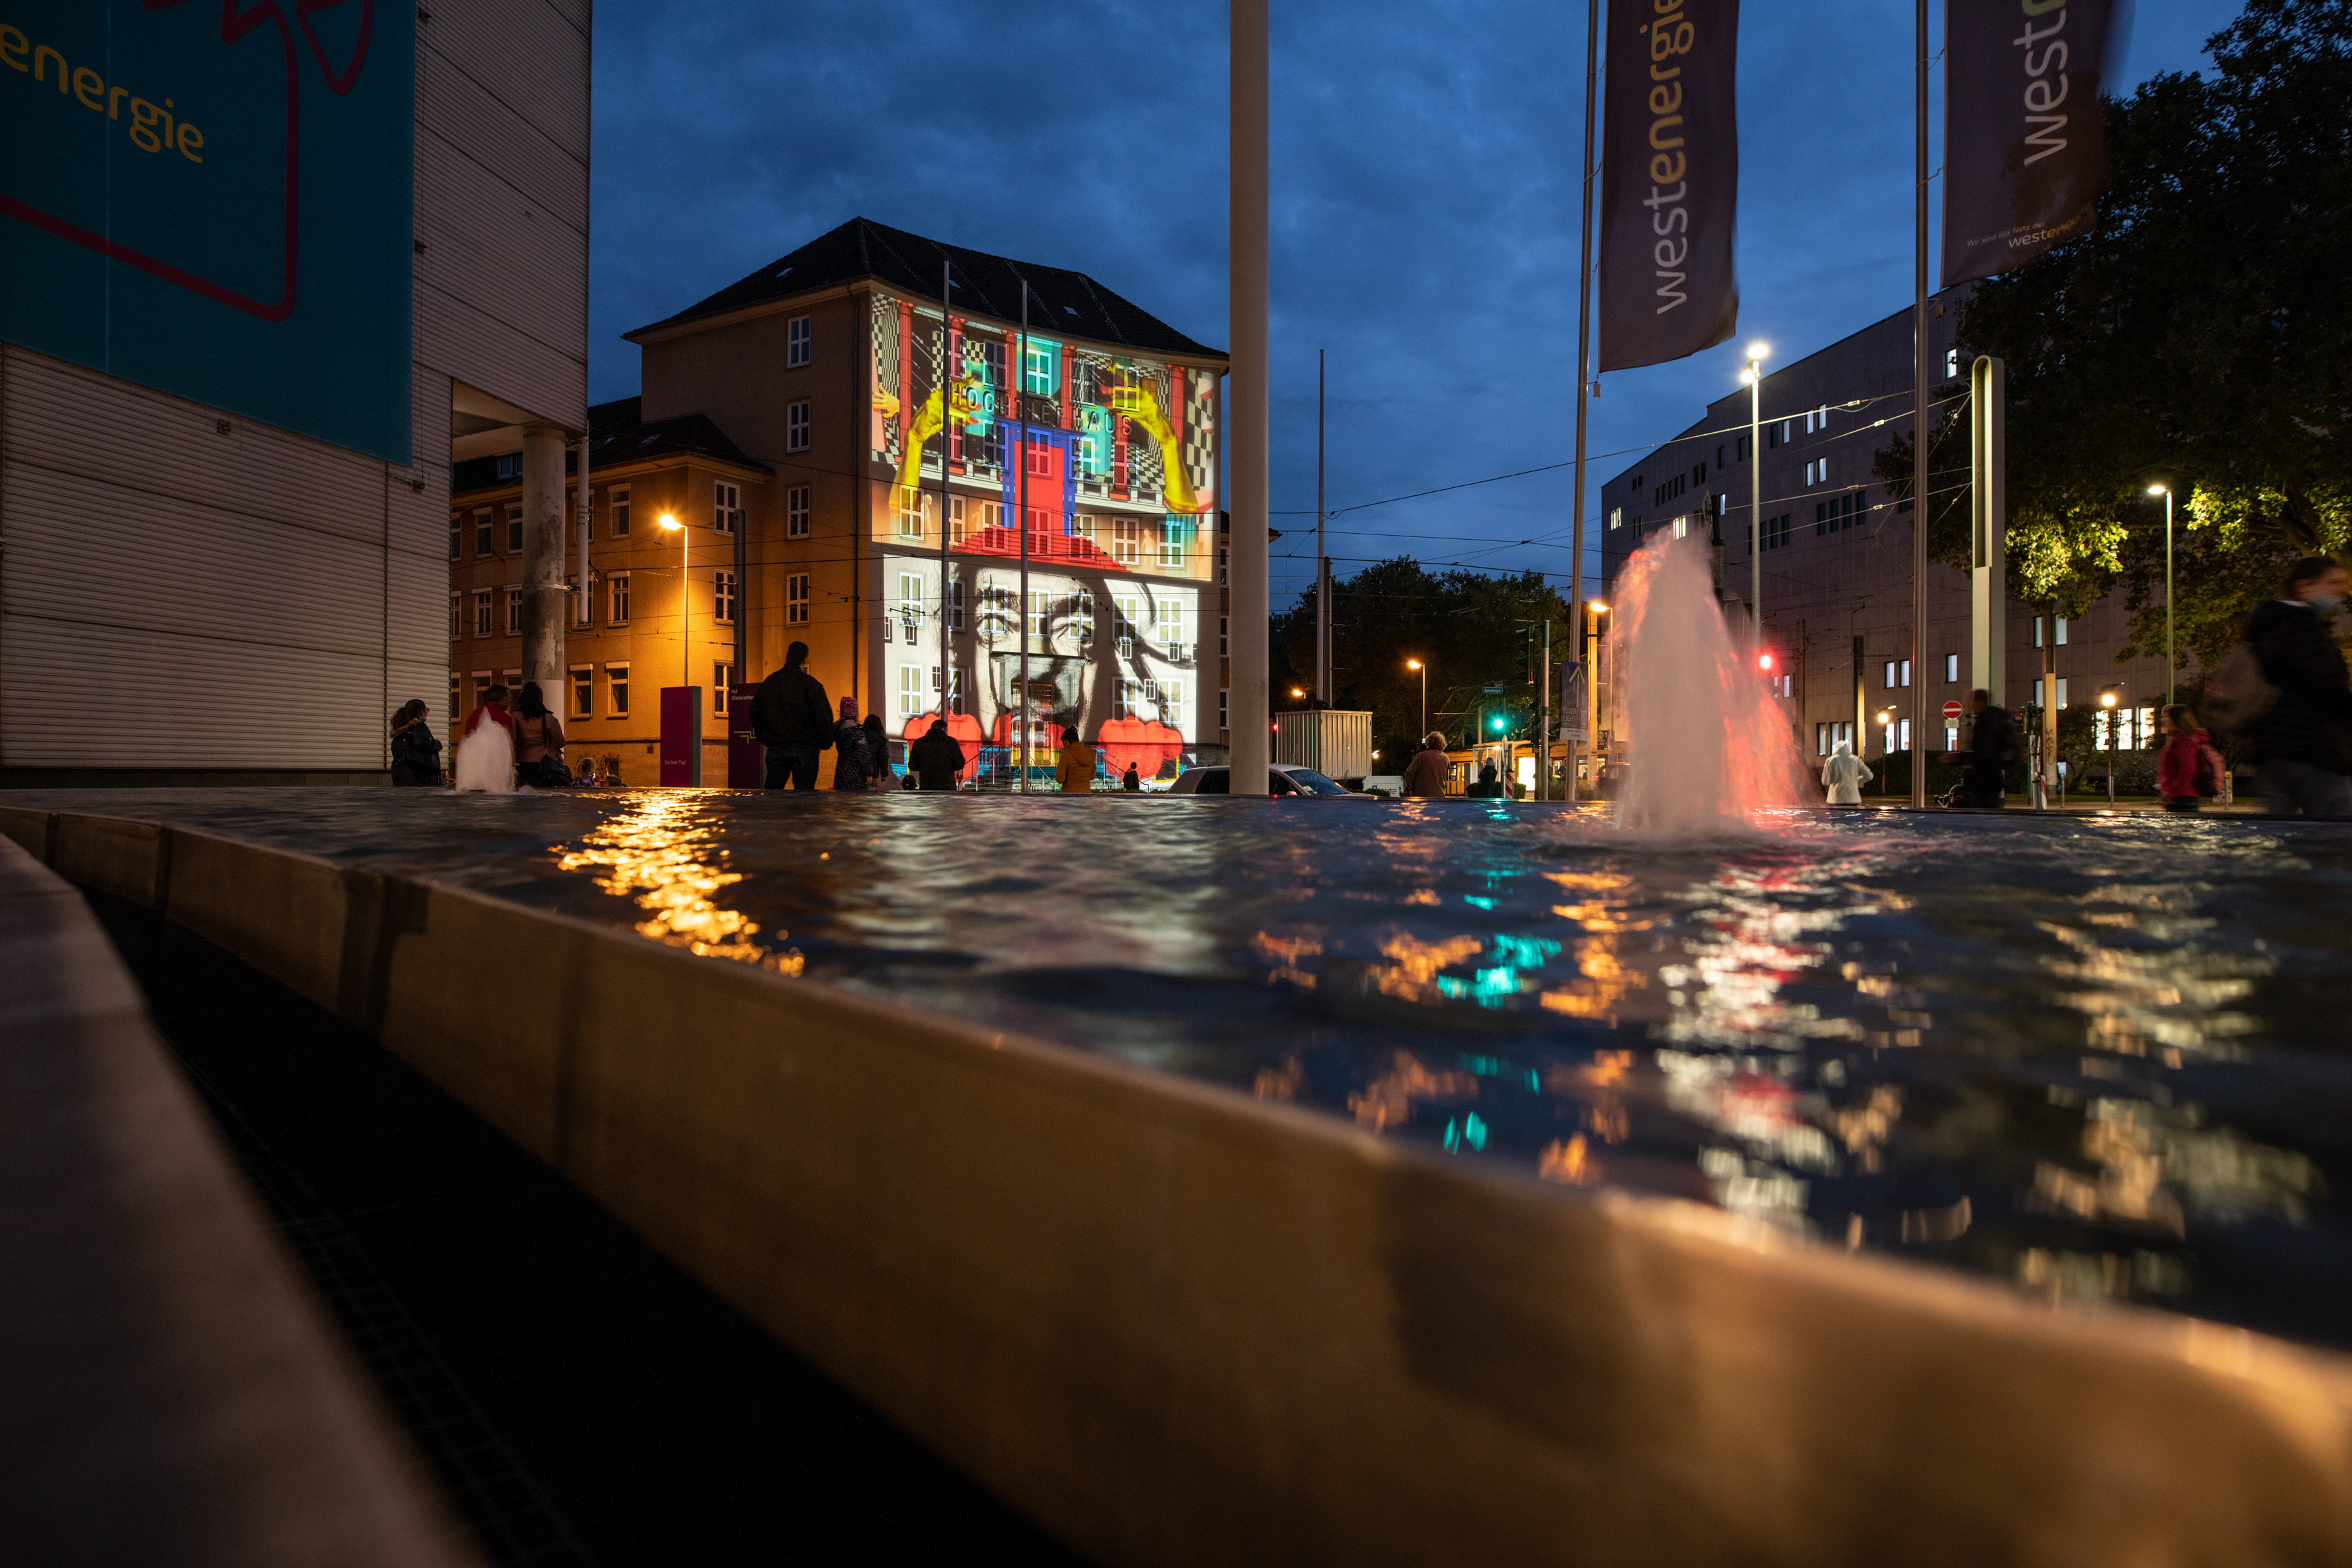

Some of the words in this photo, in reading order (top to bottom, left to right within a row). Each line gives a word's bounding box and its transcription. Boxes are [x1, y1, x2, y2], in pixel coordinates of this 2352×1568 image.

[2012, 225, 2031, 234] Netz
[2032, 221, 2046, 230] der
[1073, 409, 1132, 435] HAUS
